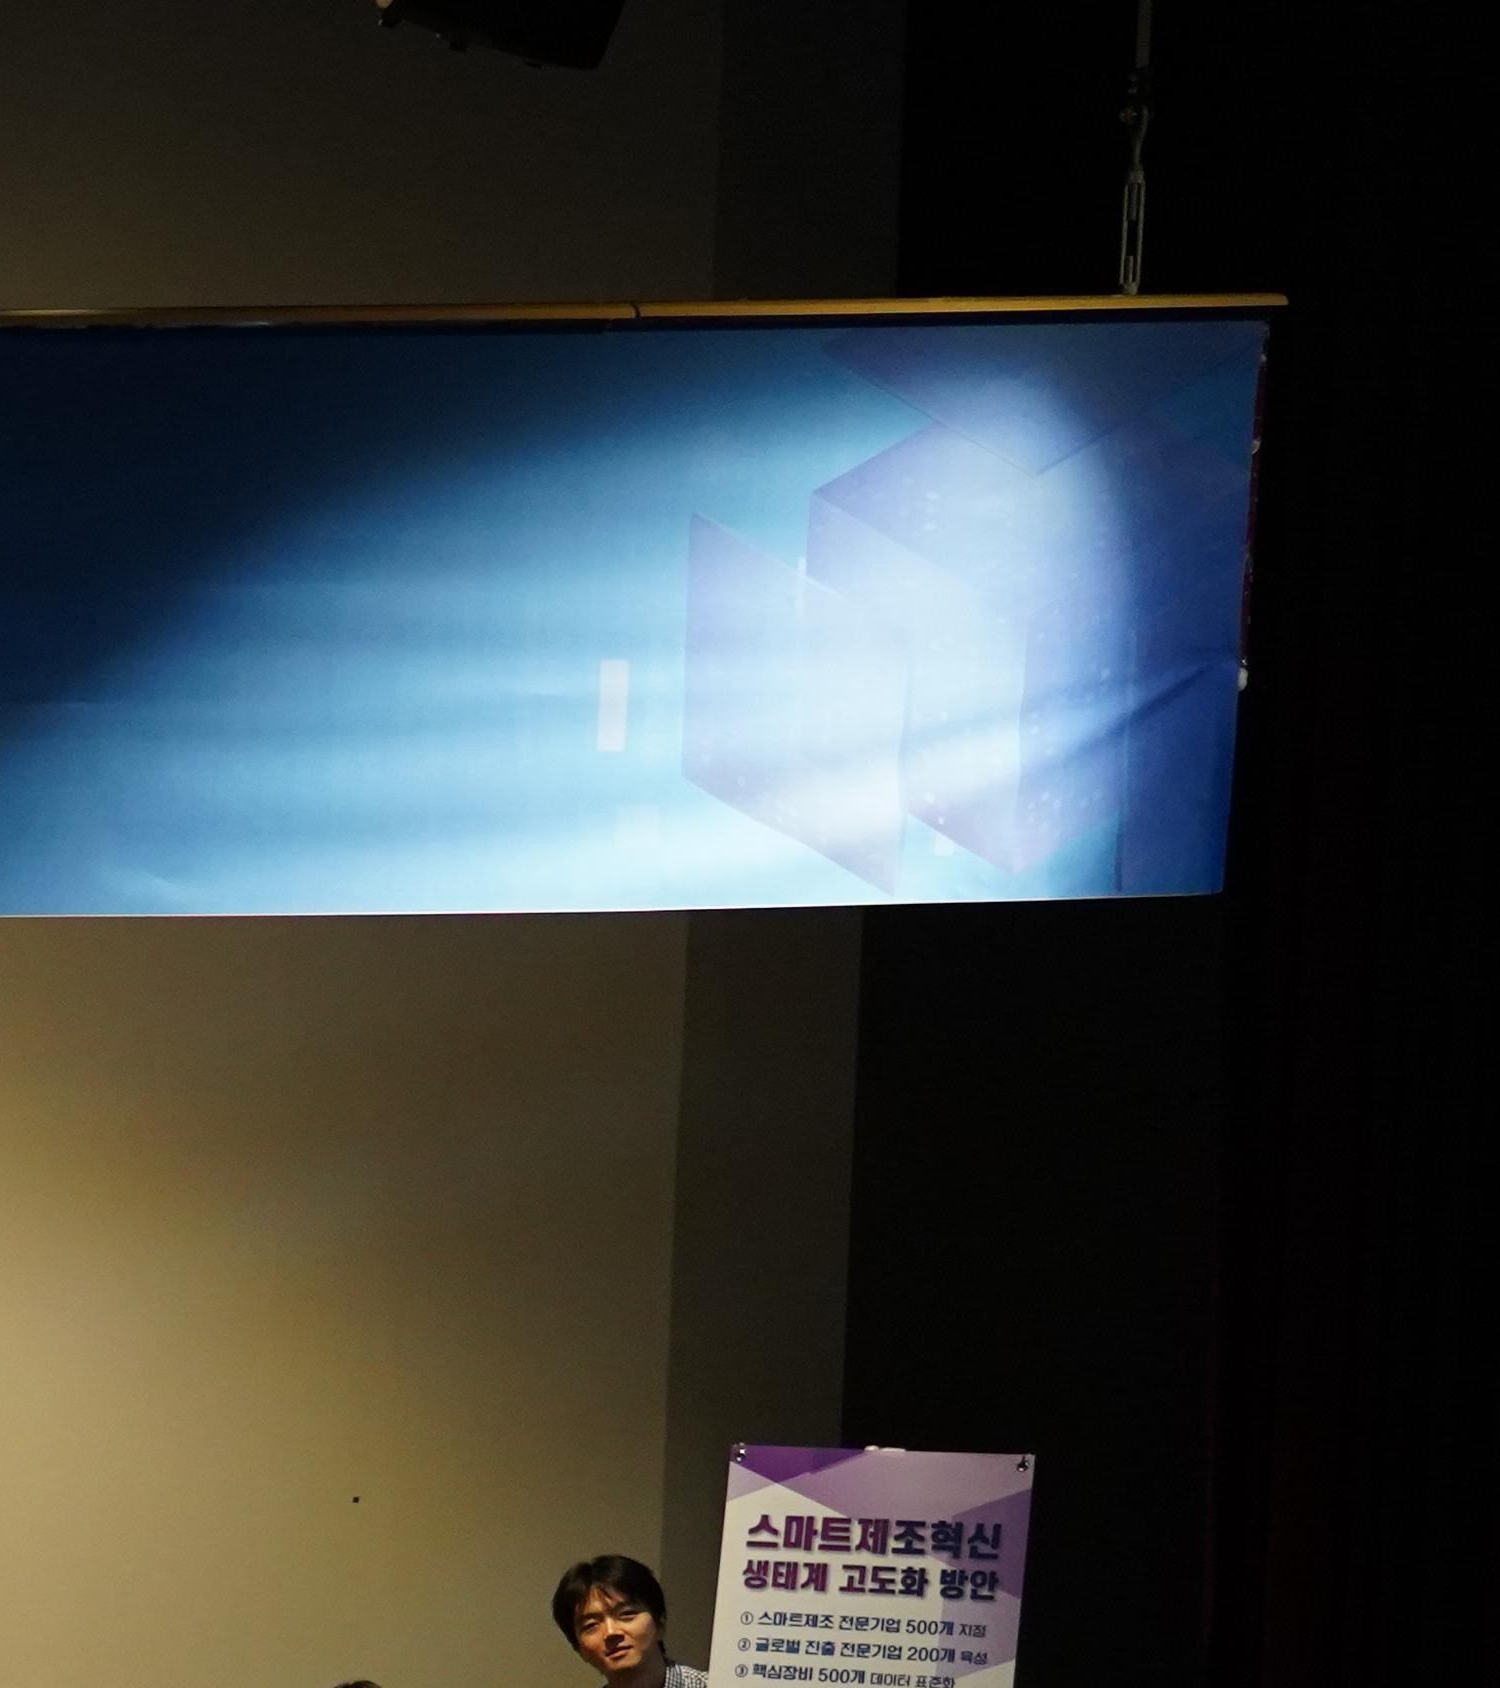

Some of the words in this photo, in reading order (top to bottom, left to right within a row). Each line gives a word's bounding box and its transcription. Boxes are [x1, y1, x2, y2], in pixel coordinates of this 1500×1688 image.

[746, 1514, 1001, 1560] 스마트제조혁신
[743, 1559, 829, 1592] 생태계
[839, 1564, 928, 1597] 고도화
[939, 1568, 999, 1601] 방안
[757, 1611, 834, 1629] 스마트제조
[839, 1616, 900, 1634] 전문기업
[906, 1620, 953, 1638] 500개
[959, 1624, 987, 1639] 지정
[755, 1637, 800, 1653] 글로벌
[805, 1640, 835, 1656] 진출
[840, 1642, 902, 1660] 전문기업
[907, 1646, 955, 1664] 200개
[961, 1650, 988, 1666] 육성
[753, 1663, 813, 1681] 핵심장비
[818, 1667, 865, 1685] 500개
[870, 1671, 911, 1688] 데이터
